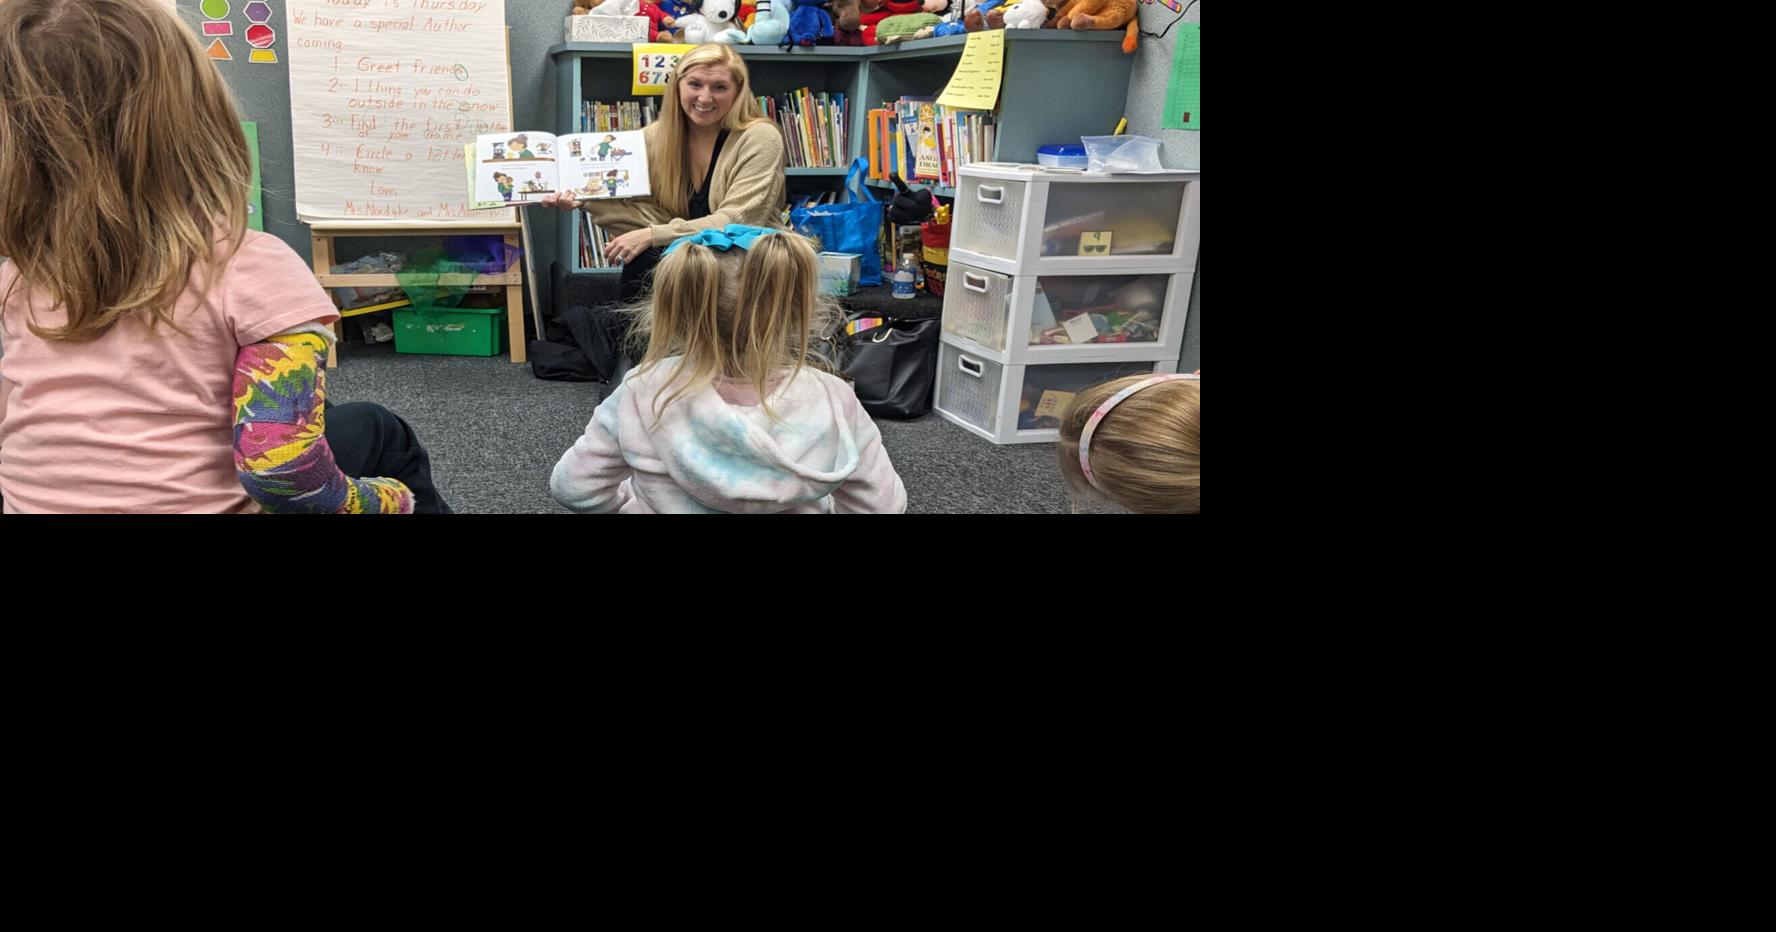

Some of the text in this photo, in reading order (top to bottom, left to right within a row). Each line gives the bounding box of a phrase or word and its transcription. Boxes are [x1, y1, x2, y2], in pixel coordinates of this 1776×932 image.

[292, 8, 473, 33] We have a special Author
[296, 38, 343, 53] coming
[357, 56, 401, 73] Greet
[412, 58, 465, 75] friends
[641, 54, 681, 69] 1 2 3
[638, 70, 650, 84] 6
[651, 71, 663, 85] 7
[367, 79, 402, 97] thing
[414, 86, 432, 99] you
[437, 86, 460, 96] can
[463, 82, 481, 97] do
[347, 95, 499, 113] outside in the snow
[350, 112, 377, 130] Find
[393, 117, 417, 131] the
[425, 116, 462, 133] first
[355, 143, 394, 160] Circle
[404, 151, 414, 161] a
[351, 158, 385, 174] know
